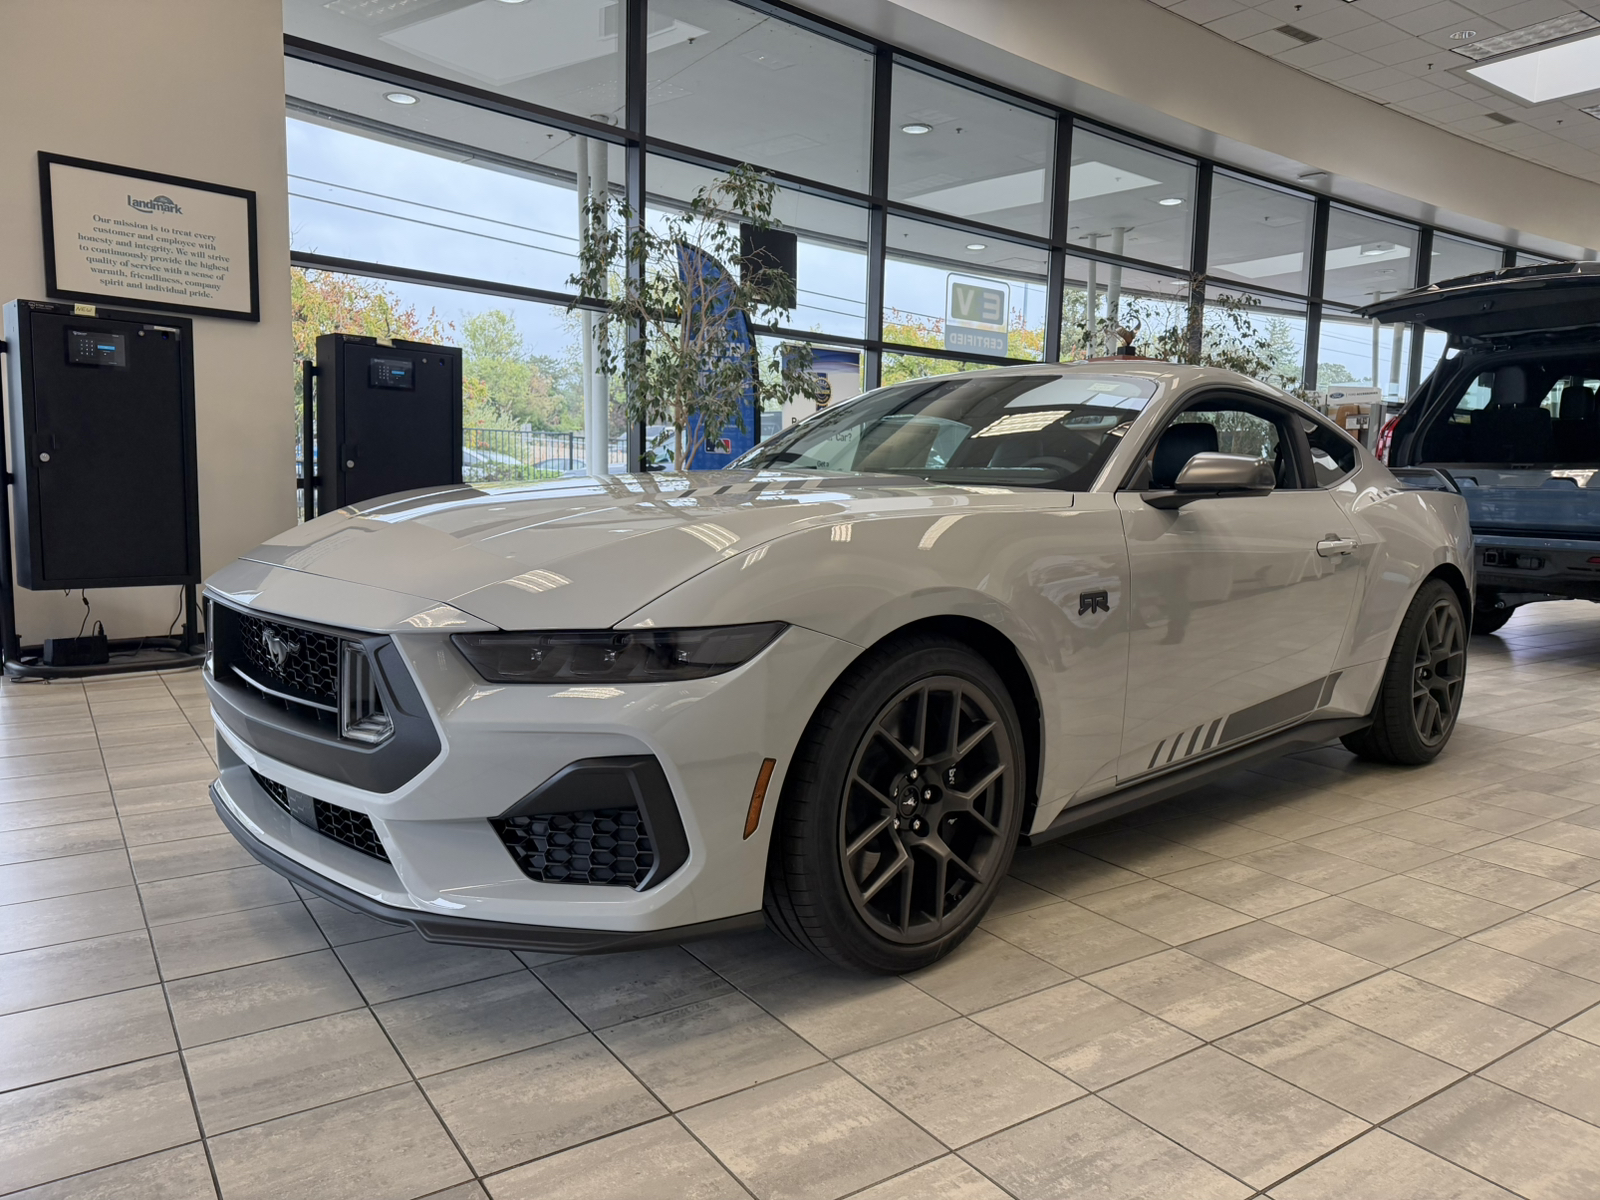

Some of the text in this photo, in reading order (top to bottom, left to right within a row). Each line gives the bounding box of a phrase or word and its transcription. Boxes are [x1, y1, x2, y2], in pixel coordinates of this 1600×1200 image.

[127, 194, 183, 215] Landmark
[92, 214, 111, 224] Our
[113, 219, 148, 230] mission
[150, 223, 158, 231] is
[172, 228, 192, 237] treat
[194, 232, 216, 243] every
[93, 226, 216, 251] customer and employee with
[77, 232, 230, 263] honesty and integrity. We will strive
[91, 246, 148, 261] continuously
[150, 255, 182, 265] provide
[184, 259, 198, 267] the
[200, 261, 229, 272] highest
[86, 256, 117, 267] quality
[130, 262, 161, 272] service
[163, 266, 182, 275] with
[191, 271, 214, 280] sense
[216, 273, 225, 281] of
[90, 267, 221, 292] warmth, friendliness, company
[99, 278, 124, 287] spirit
[145, 283, 187, 295] individual
[189, 290, 213, 299] pride.
